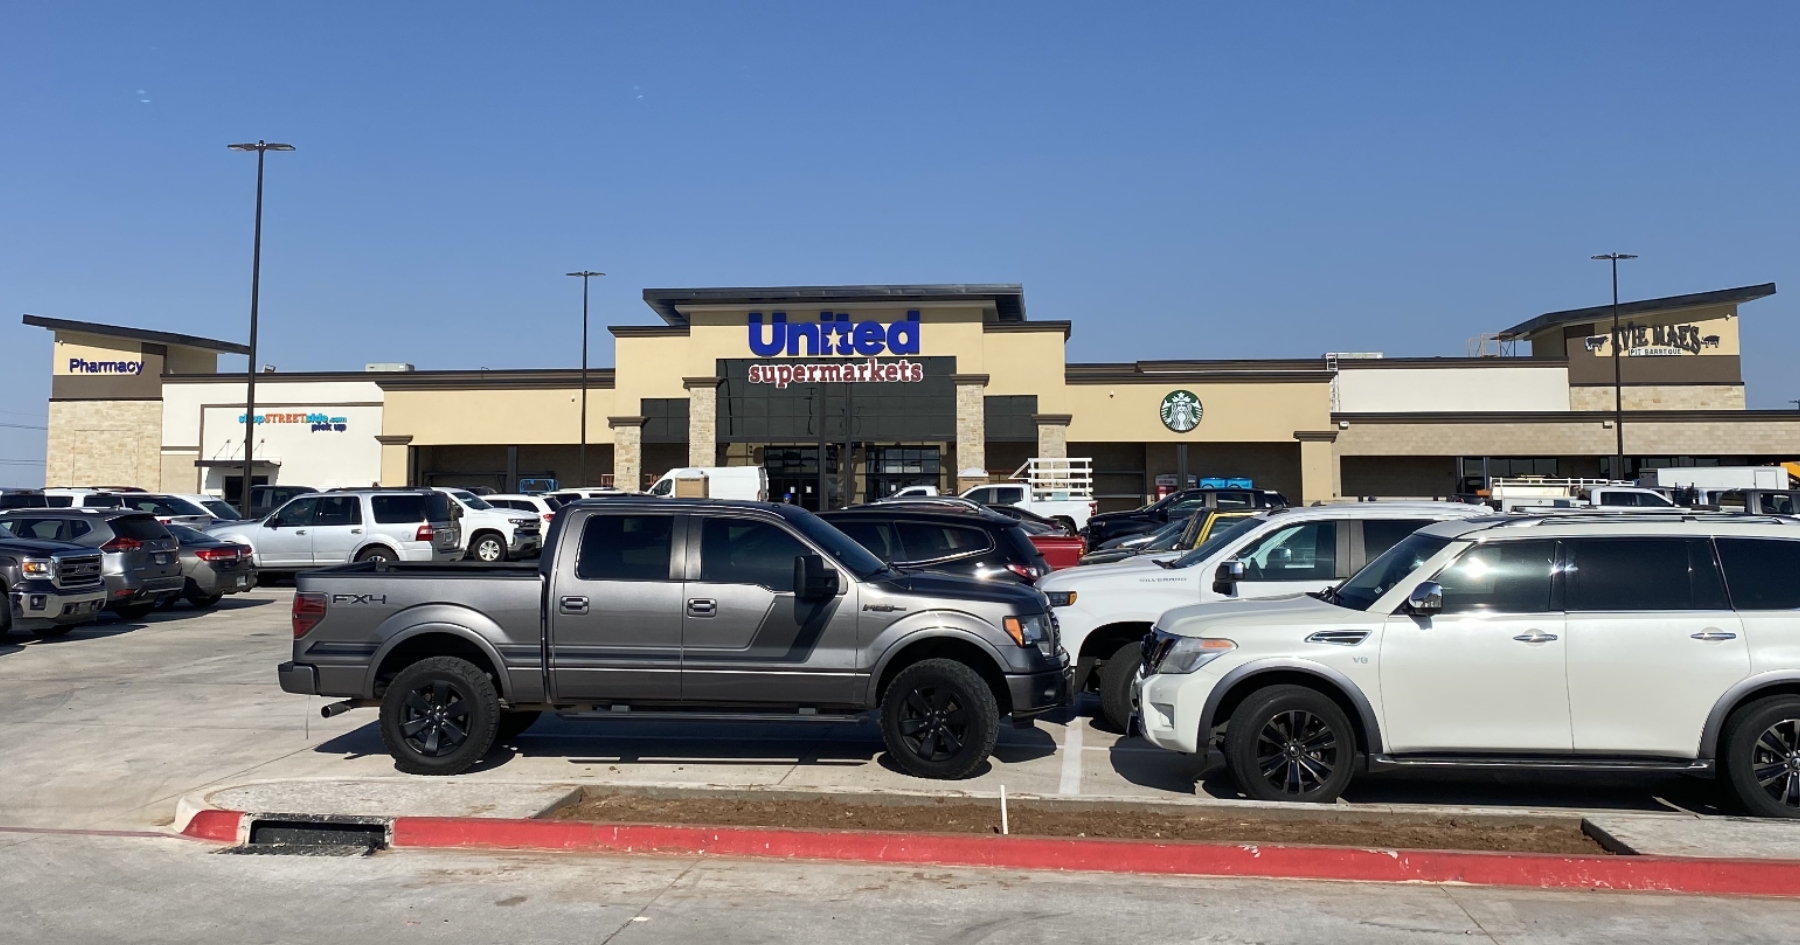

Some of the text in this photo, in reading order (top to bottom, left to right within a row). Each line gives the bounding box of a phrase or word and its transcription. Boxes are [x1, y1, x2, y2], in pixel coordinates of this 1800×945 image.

[748, 310, 920, 356] United
[1652, 323, 1702, 355] MAE'S
[69, 358, 145, 375] Pharmacy
[748, 357, 923, 389] supermarkets
[311, 422, 347, 433] pick up
[332, 593, 387, 605] FX4
